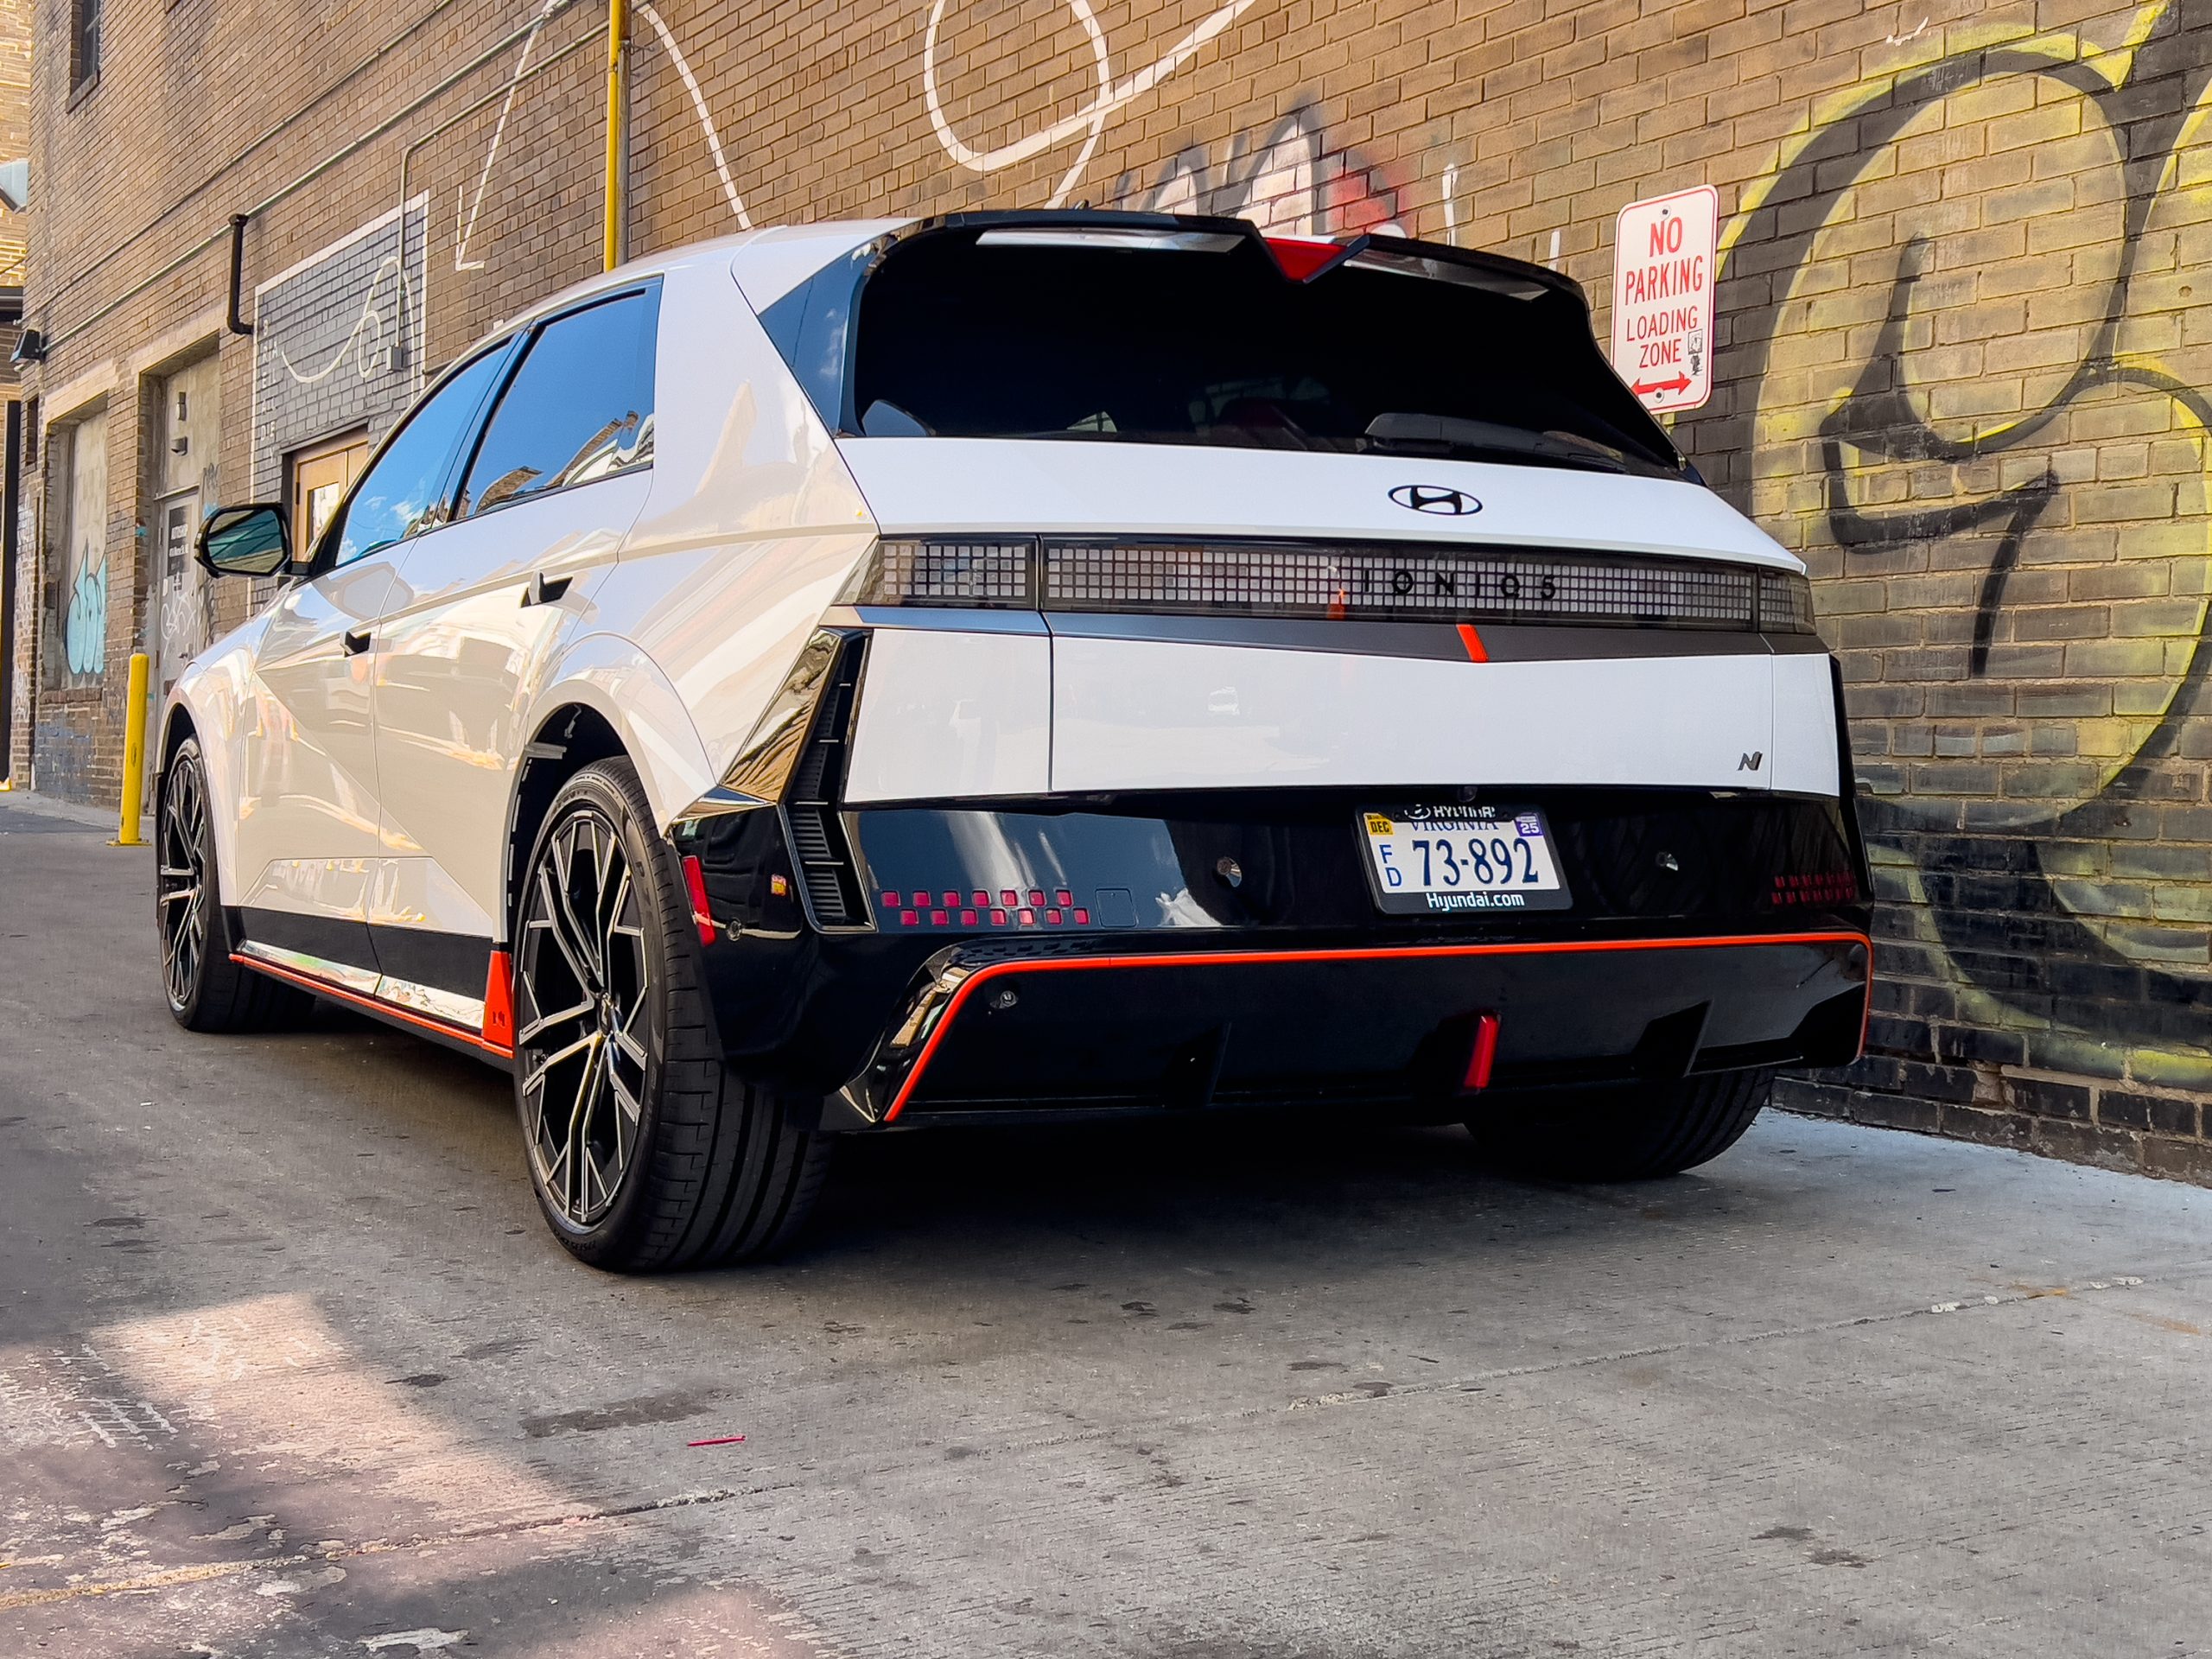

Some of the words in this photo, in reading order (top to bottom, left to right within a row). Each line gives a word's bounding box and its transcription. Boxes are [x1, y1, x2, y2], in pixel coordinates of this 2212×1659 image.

[1649, 216, 1682, 257] NO
[1624, 255, 1703, 306] PARKING
[1626, 305, 1698, 342] LOADING
[1638, 338, 1682, 369] ZONE
[1737, 751, 1764, 771] N
[1370, 821, 1390, 833] DEC
[1520, 822, 1540, 834] 25
[1412, 837, 1539, 887] 73-892
[1426, 892, 1525, 912] Hyundai.com
